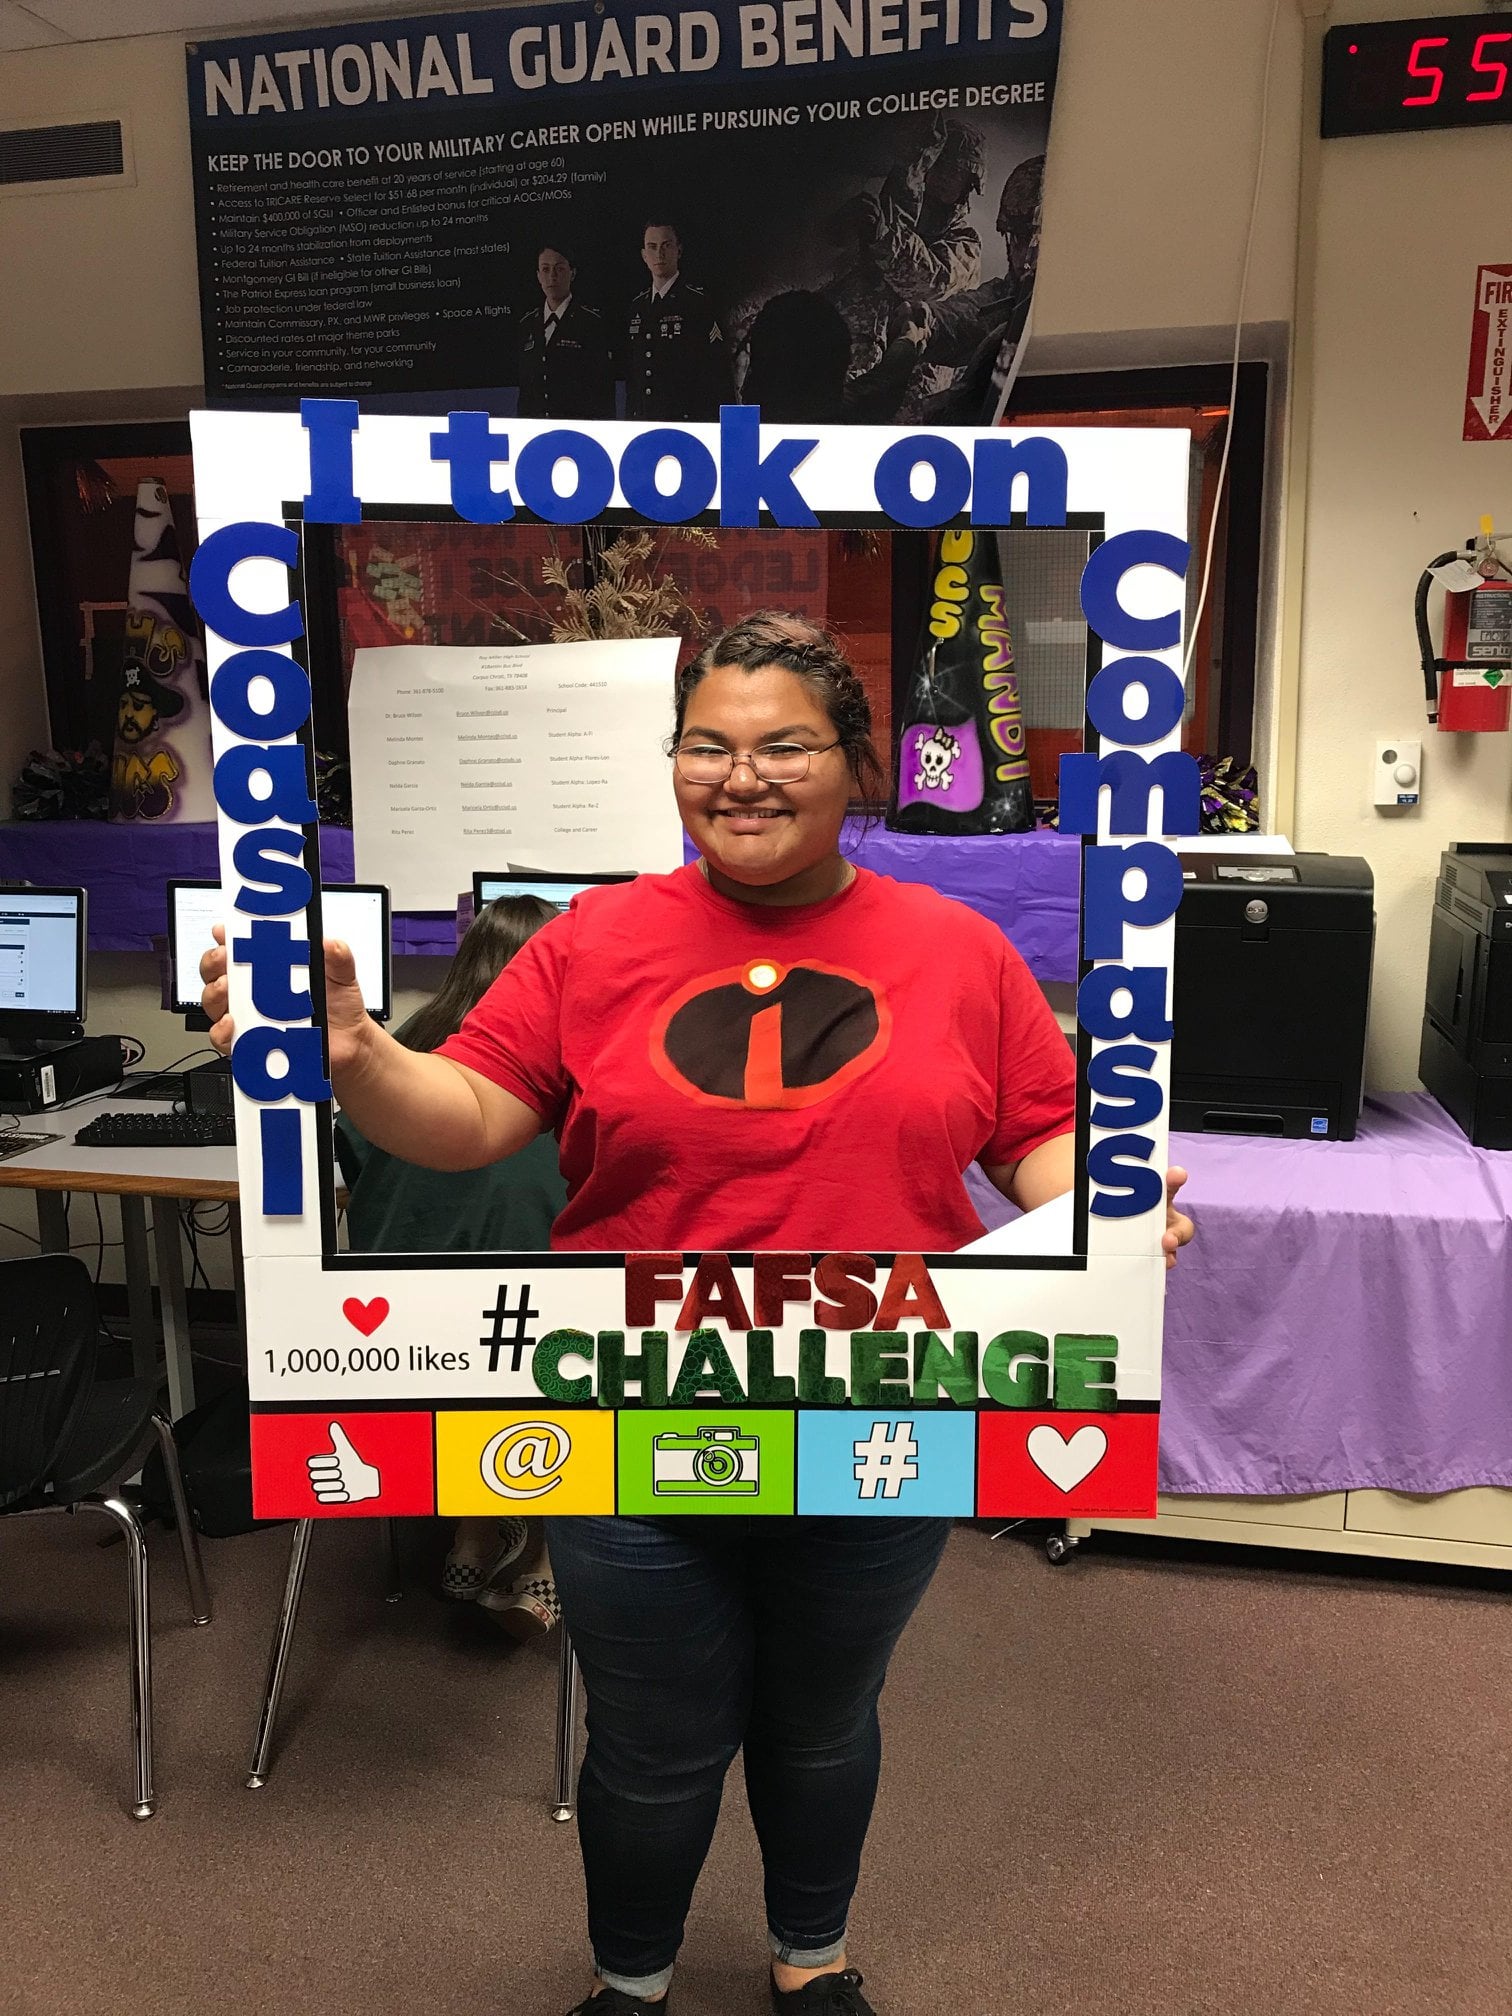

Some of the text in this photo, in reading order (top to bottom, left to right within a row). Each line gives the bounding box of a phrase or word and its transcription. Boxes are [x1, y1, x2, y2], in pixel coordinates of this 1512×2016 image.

[203, 0, 1048, 116] NATIONAL GUARD BENEFITS
[208, 81, 1046, 172] KEEP THE DOOR TO YOUR MILITARY CAREER OPEN WHILE PURSUING YOUR COLLEGE DEGREE
[217, 182, 268, 193] Retirement
[270, 181, 288, 191] and
[290, 180, 320, 190] health
[347, 176, 379, 187] benefit
[381, 175, 391, 184] at
[393, 174, 404, 183] 20
[407, 174, 432, 184] years
[433, 170, 444, 180] of
[444, 167, 476, 178] service
[516, 161, 526, 171] at
[528, 161, 548, 171] age
[218, 198, 252, 208] Access
[254, 197, 264, 206] to
[304, 196, 341, 205] Reserve
[343, 192, 372, 203] Select
[374, 192, 387, 201] for
[419, 189, 435, 199] per
[436, 184, 467, 195] month
[532, 173, 568, 187] $204.29
[218, 213, 261, 223] Maintain
[302, 210, 312, 220] of
[314, 209, 334, 219] SGLI
[346, 207, 378, 217] Officer
[380, 205, 400, 215] and
[402, 202, 435, 214] Enlisted
[437, 201, 466, 210] bonus
[468, 199, 480, 208] for
[481, 195, 511, 207] critical
[220, 213, 489, 239] Military Service Obligation (MSO) reduction up to 24 months
[220, 234, 433, 256] Up to 24 months stabilization from deployments
[221, 256, 334, 268] Federal Tuition Assistance
[347, 253, 371, 263] State
[372, 251, 401, 262] Tuition
[403, 249, 450, 260] Assistance
[222, 274, 283, 285] Montgomery
[285, 273, 296, 282] GI
[298, 272, 310, 282] Bill
[320, 269, 358, 281] ineligible
[360, 268, 372, 277] for
[374, 266, 399, 276] other
[401, 265, 412, 275] GI
[223, 290, 238, 299] The
[241, 289, 272, 298] Patriot
[274, 289, 307, 300] Express
[308, 287, 328, 297] loan
[329, 286, 368, 297] program
[399, 280, 435, 290] business
[1485, 281, 1512, 304] FIR
[224, 299, 372, 315] Job protection under federal law
[442, 305, 511, 320] Space A flights
[225, 319, 266, 328] Maintain
[343, 315, 361, 325] and
[363, 313, 386, 323] MWR
[388, 311, 430, 324] privileges
[225, 328, 400, 343] Discounted rates at major theme parks
[226, 349, 260, 358] Service
[262, 348, 270, 357] in
[272, 350, 293, 359] your
[350, 345, 363, 354] for
[364, 346, 385, 355] your
[386, 341, 436, 352] community
[344, 360, 362, 370] and
[364, 358, 414, 369] networking
[300, 398, 1068, 528] I took on
[625, 1252, 952, 1332] FAFSA
[264, 1345, 470, 1377] 1,000,000 likes
